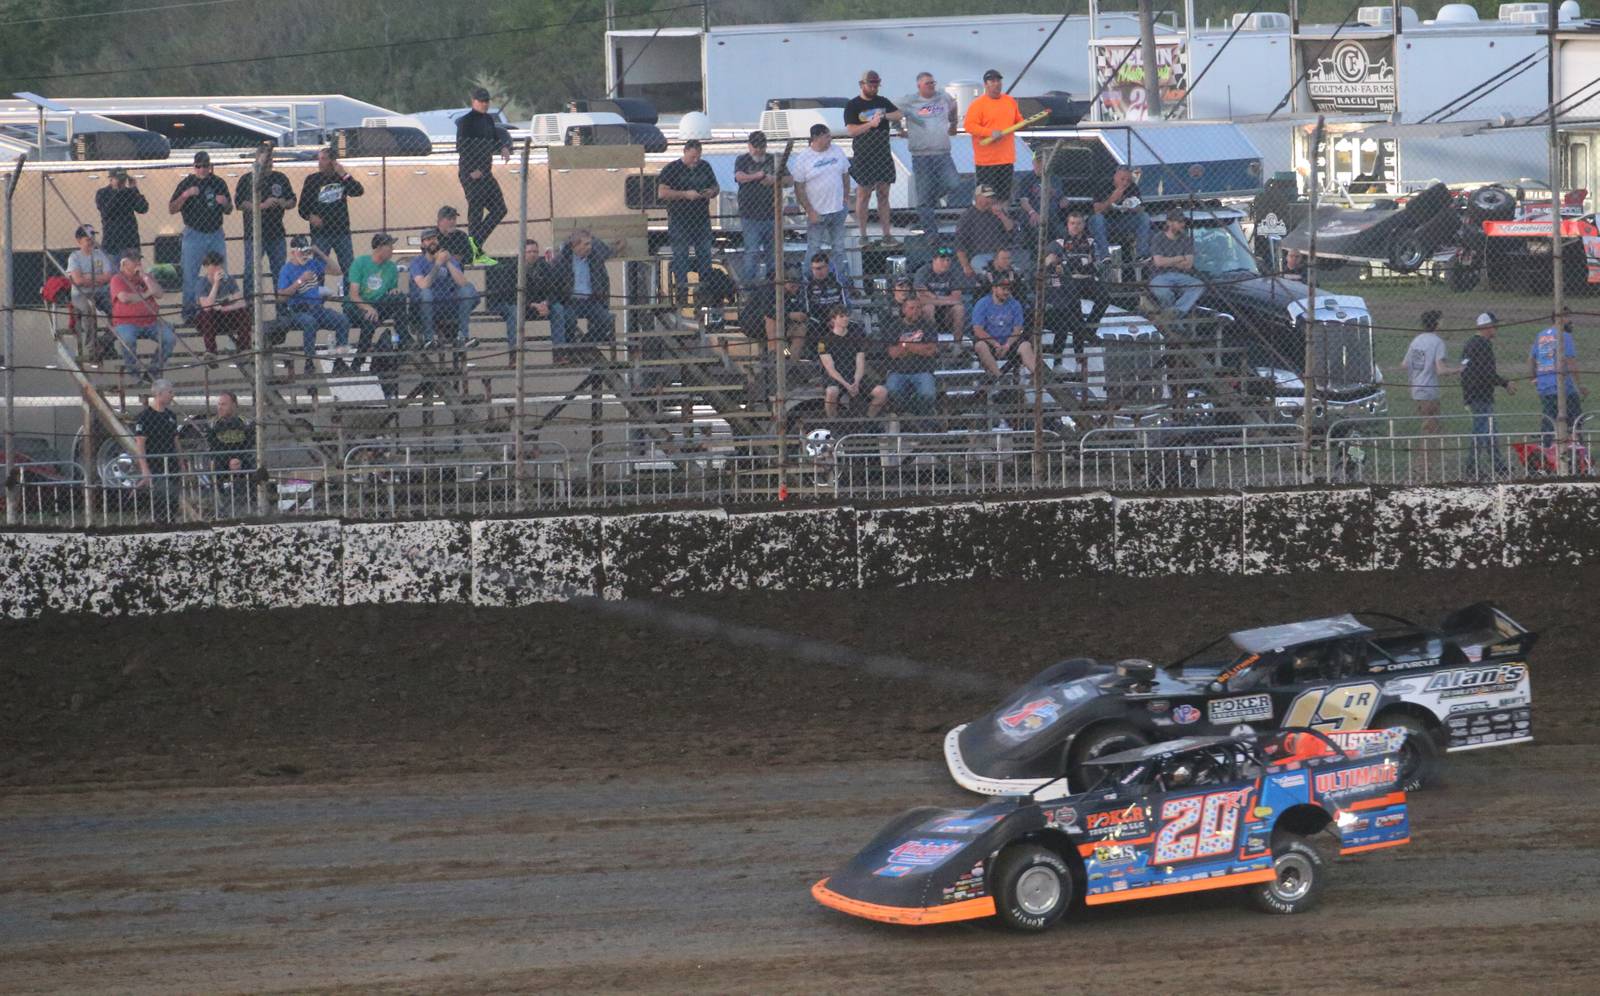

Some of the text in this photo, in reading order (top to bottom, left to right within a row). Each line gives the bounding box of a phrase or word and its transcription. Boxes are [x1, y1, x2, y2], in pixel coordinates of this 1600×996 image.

[1313, 84, 1358, 94] COLTMAN
[1337, 96, 1375, 105] RACING
[1387, 658, 1441, 671] CHEVROLET
[1429, 666, 1525, 690] Alan's
[1211, 696, 1270, 713] HOKER
[1315, 763, 1399, 793] ULTIMATE
[1087, 806, 1145, 830] HOKER
[1154, 792, 1239, 865] 20
